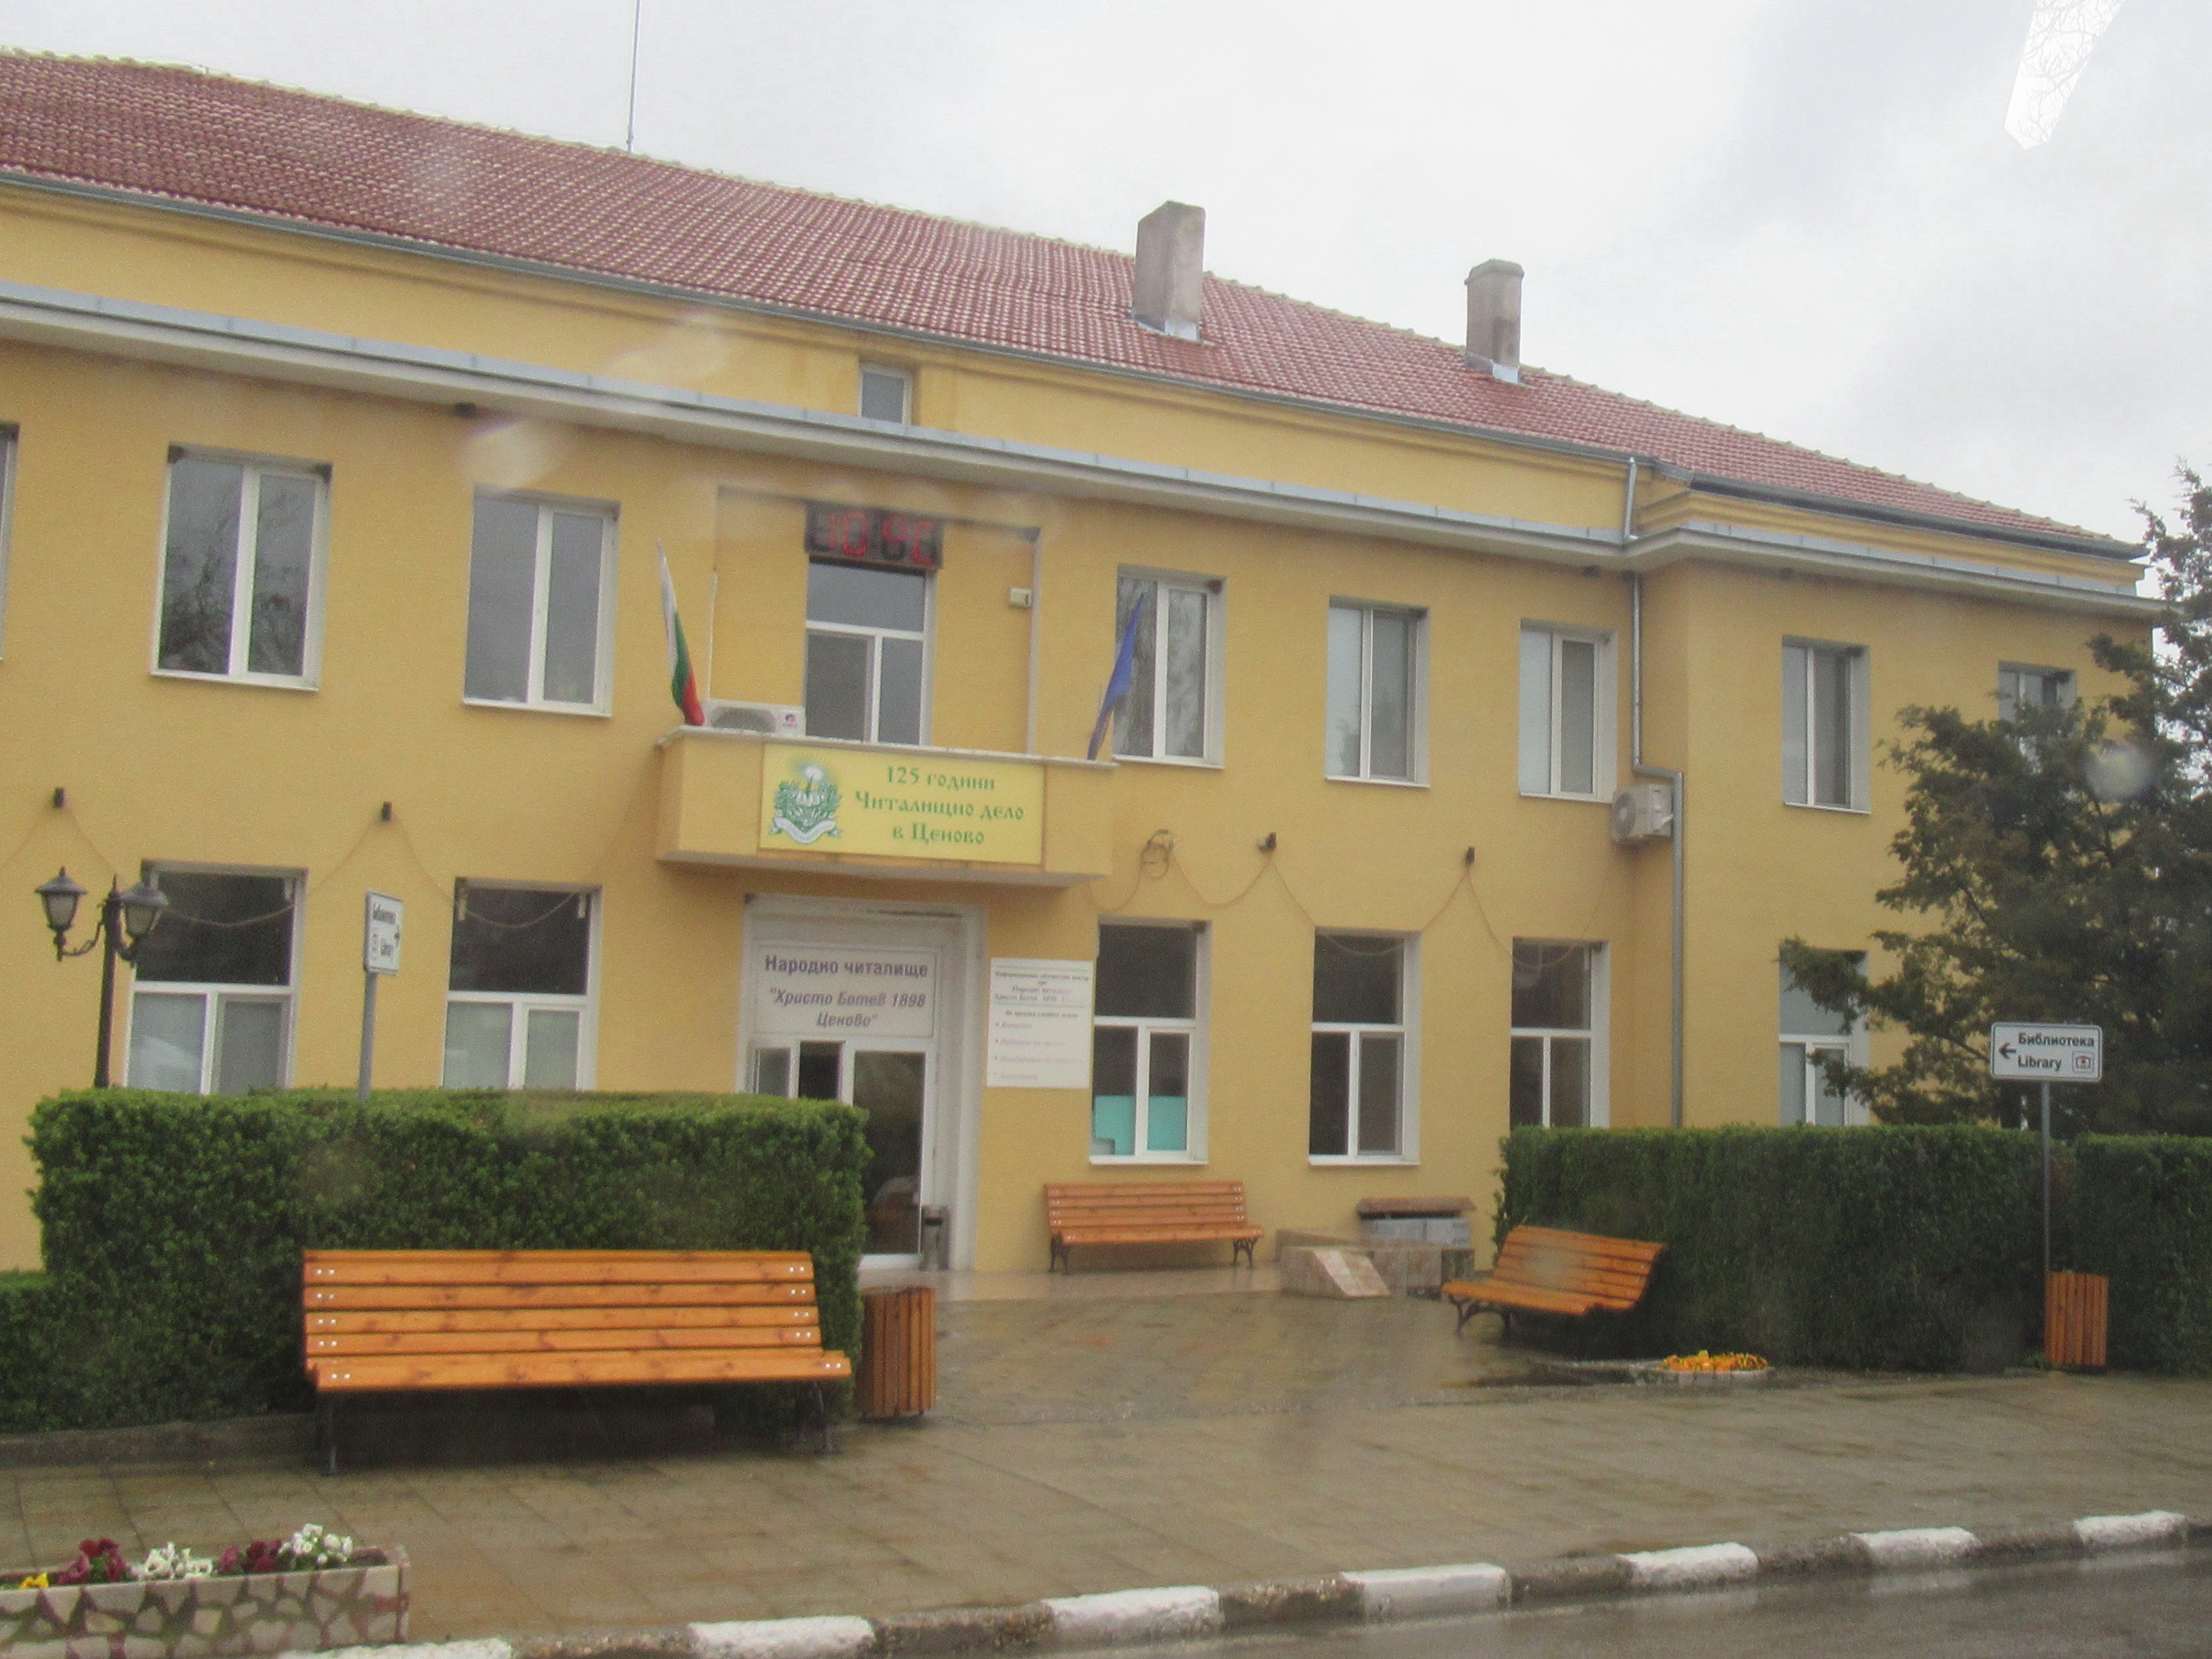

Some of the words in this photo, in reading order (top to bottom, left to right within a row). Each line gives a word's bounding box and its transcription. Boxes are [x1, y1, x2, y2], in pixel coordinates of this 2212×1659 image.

[886, 765, 920, 785] 125
[927, 773, 995, 791] години
[855, 790, 974, 817] Читалищно
[979, 805, 1025, 821] дело
[892, 825, 904, 840] в
[911, 823, 985, 846] Ценово
[764, 954, 839, 976] Народно
[843, 960, 928, 979] читалище
[837, 992, 887, 1007] Ботев
[2018, 1032, 2095, 1046] Библиотека
[2017, 1054, 2062, 1072] Library
